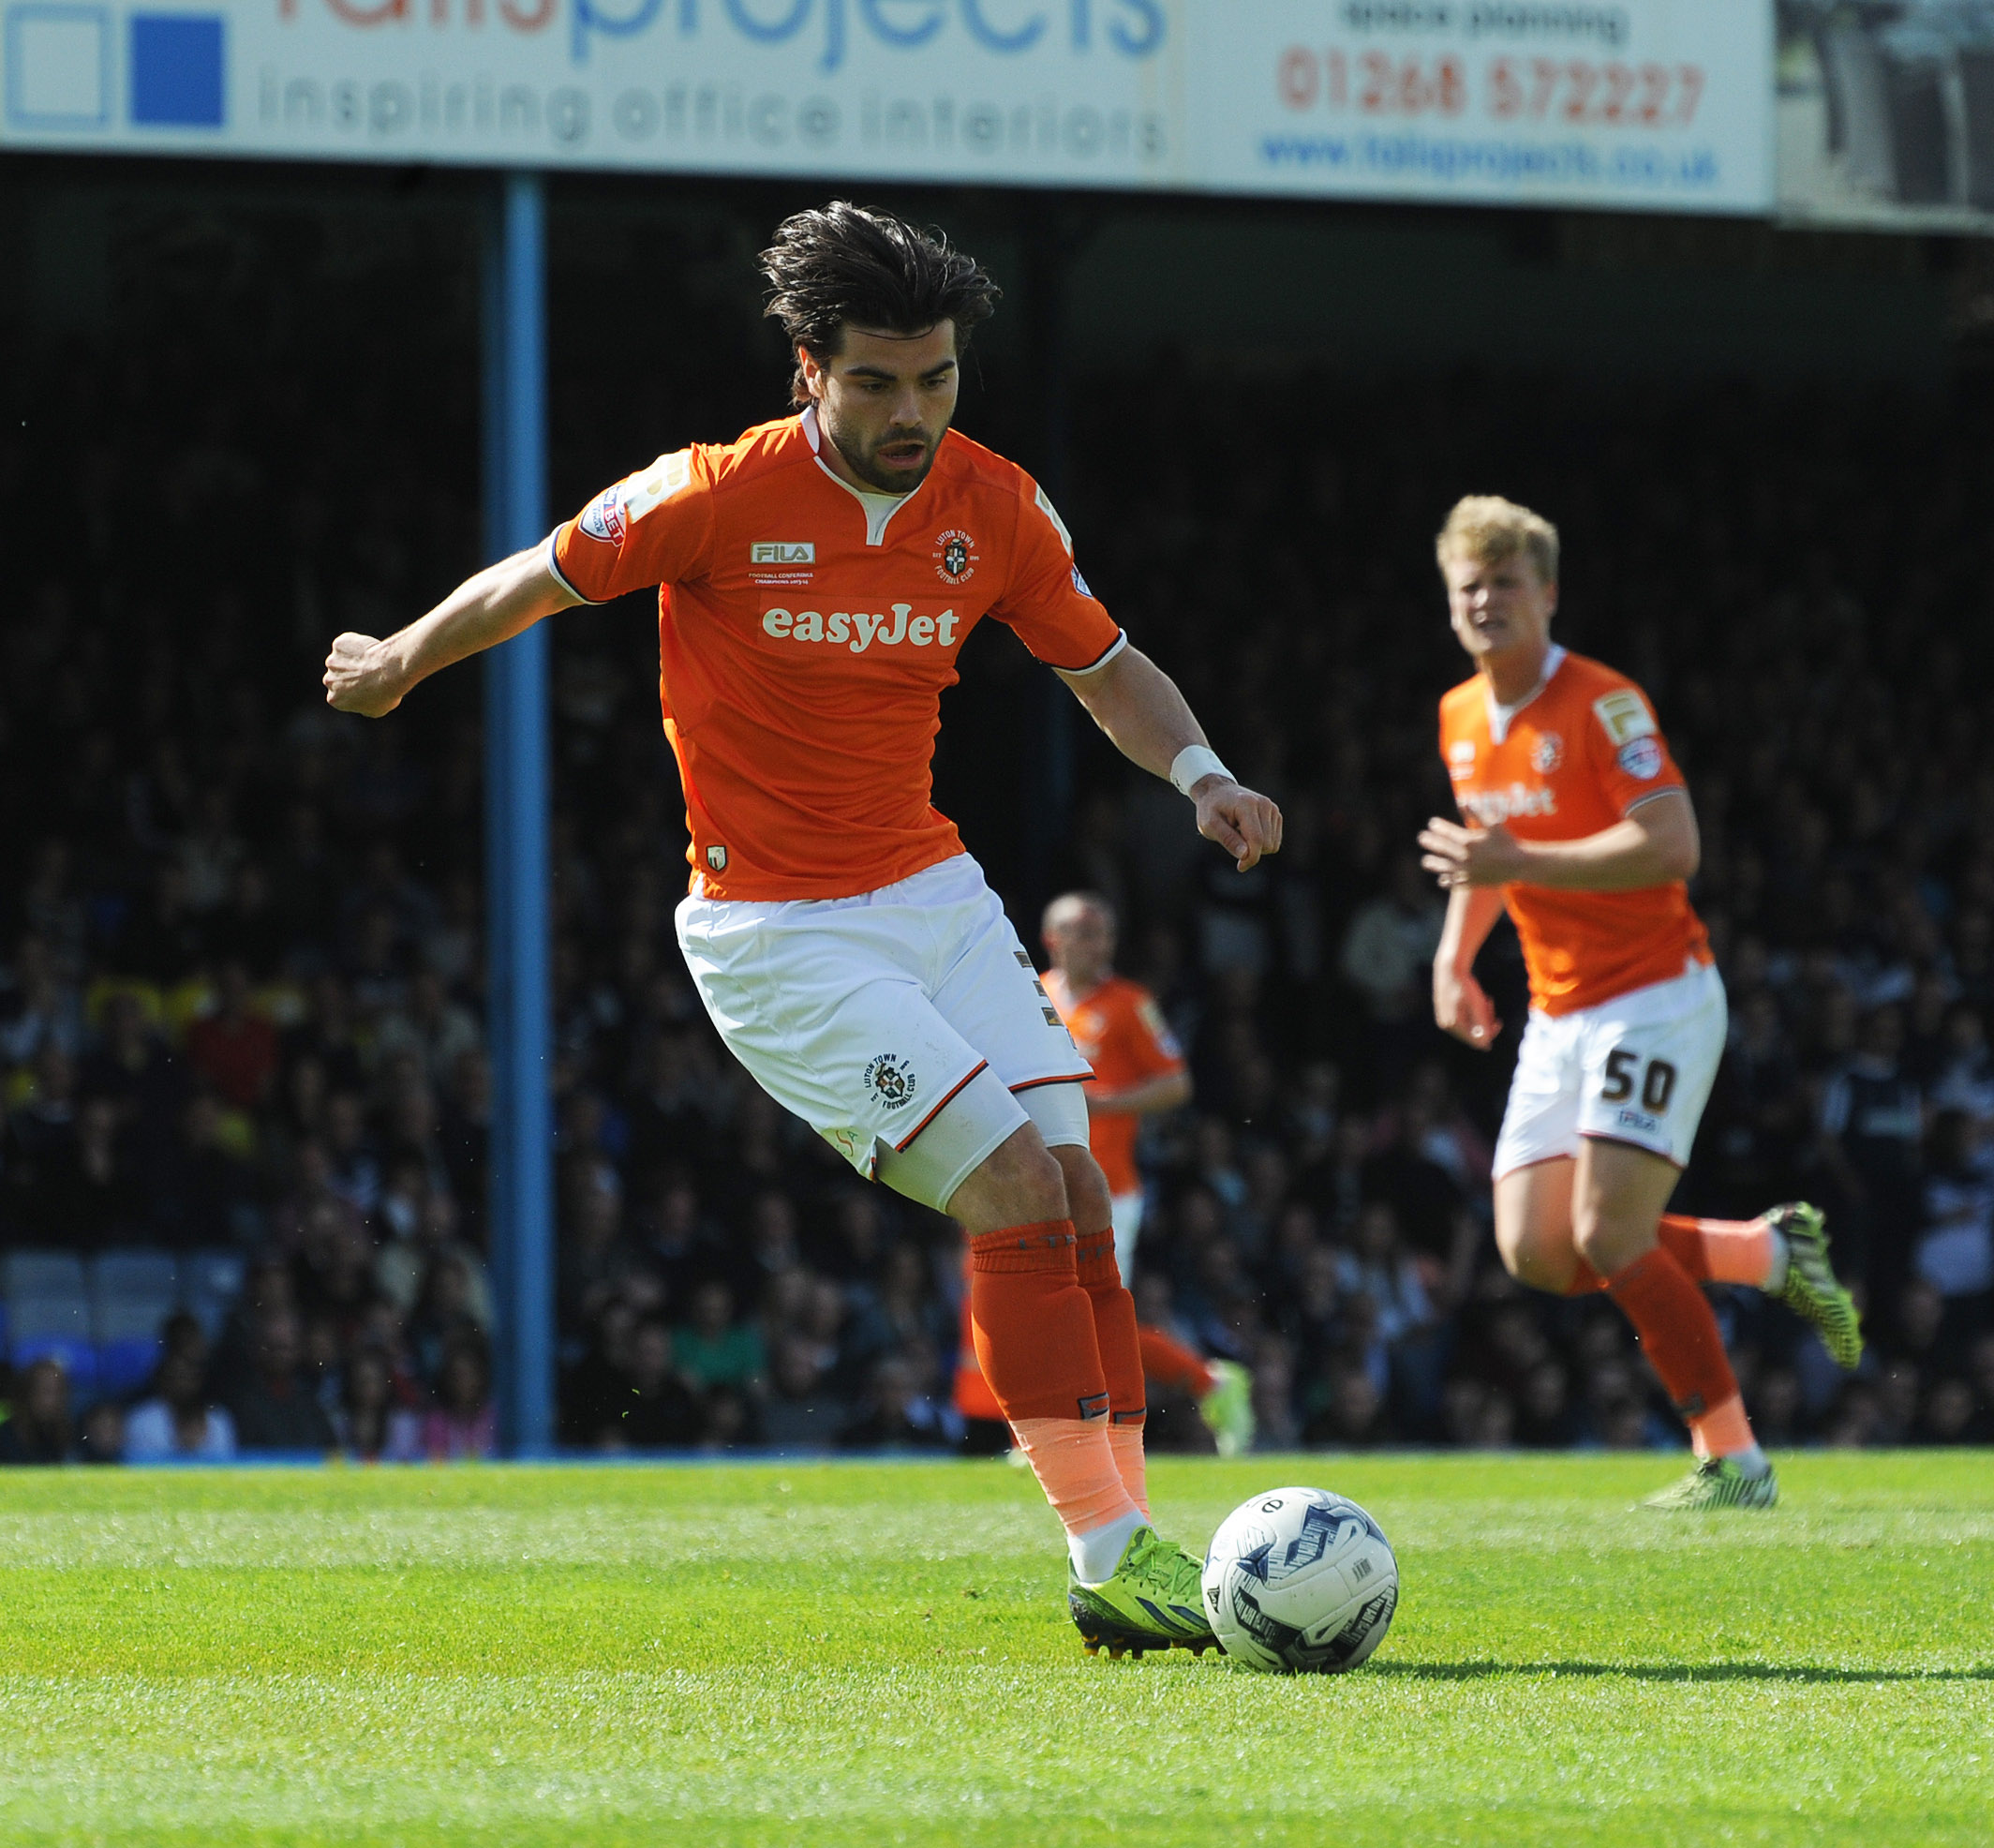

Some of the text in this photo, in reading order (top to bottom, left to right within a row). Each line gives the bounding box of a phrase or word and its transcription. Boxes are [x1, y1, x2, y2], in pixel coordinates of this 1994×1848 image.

[1277, 44, 1707, 127] 01268 572227
[258, 62, 1168, 163] inspiring office interiors
[605, 509, 623, 539] BET
[935, 529, 975, 548] LUTON TOWN
[756, 545, 810, 561] FILA
[762, 603, 960, 653] easyJet
[864, 1053, 897, 1088] LUTON TOWN
[1601, 1049, 1675, 1113] 50
[882, 1073, 915, 1110] FOOTBALL CLUB
